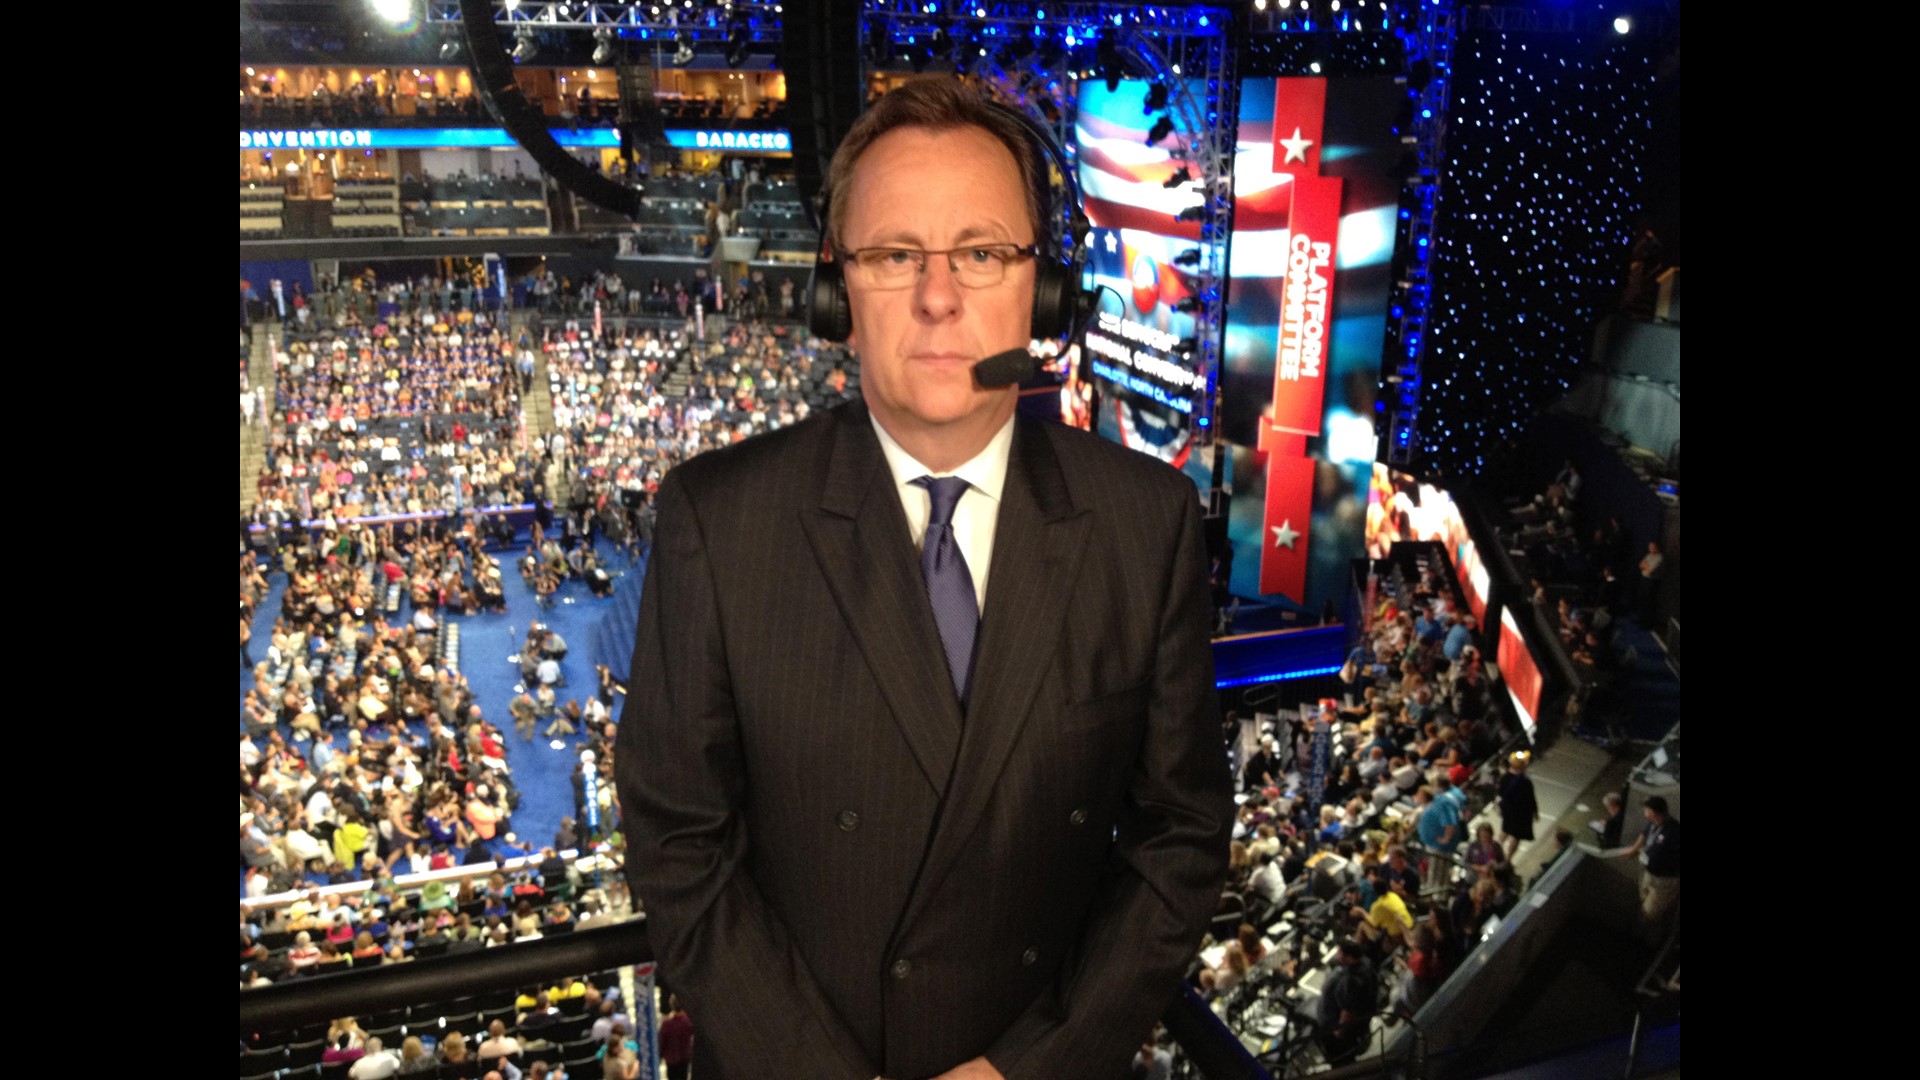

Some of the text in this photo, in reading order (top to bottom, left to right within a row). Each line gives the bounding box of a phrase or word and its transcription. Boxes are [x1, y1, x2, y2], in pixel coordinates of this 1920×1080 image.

[696, 131, 789, 149] BARACKO
[1280, 233, 1311, 382] COMMITTEE
[1300, 241, 1331, 378] PLATFORM
